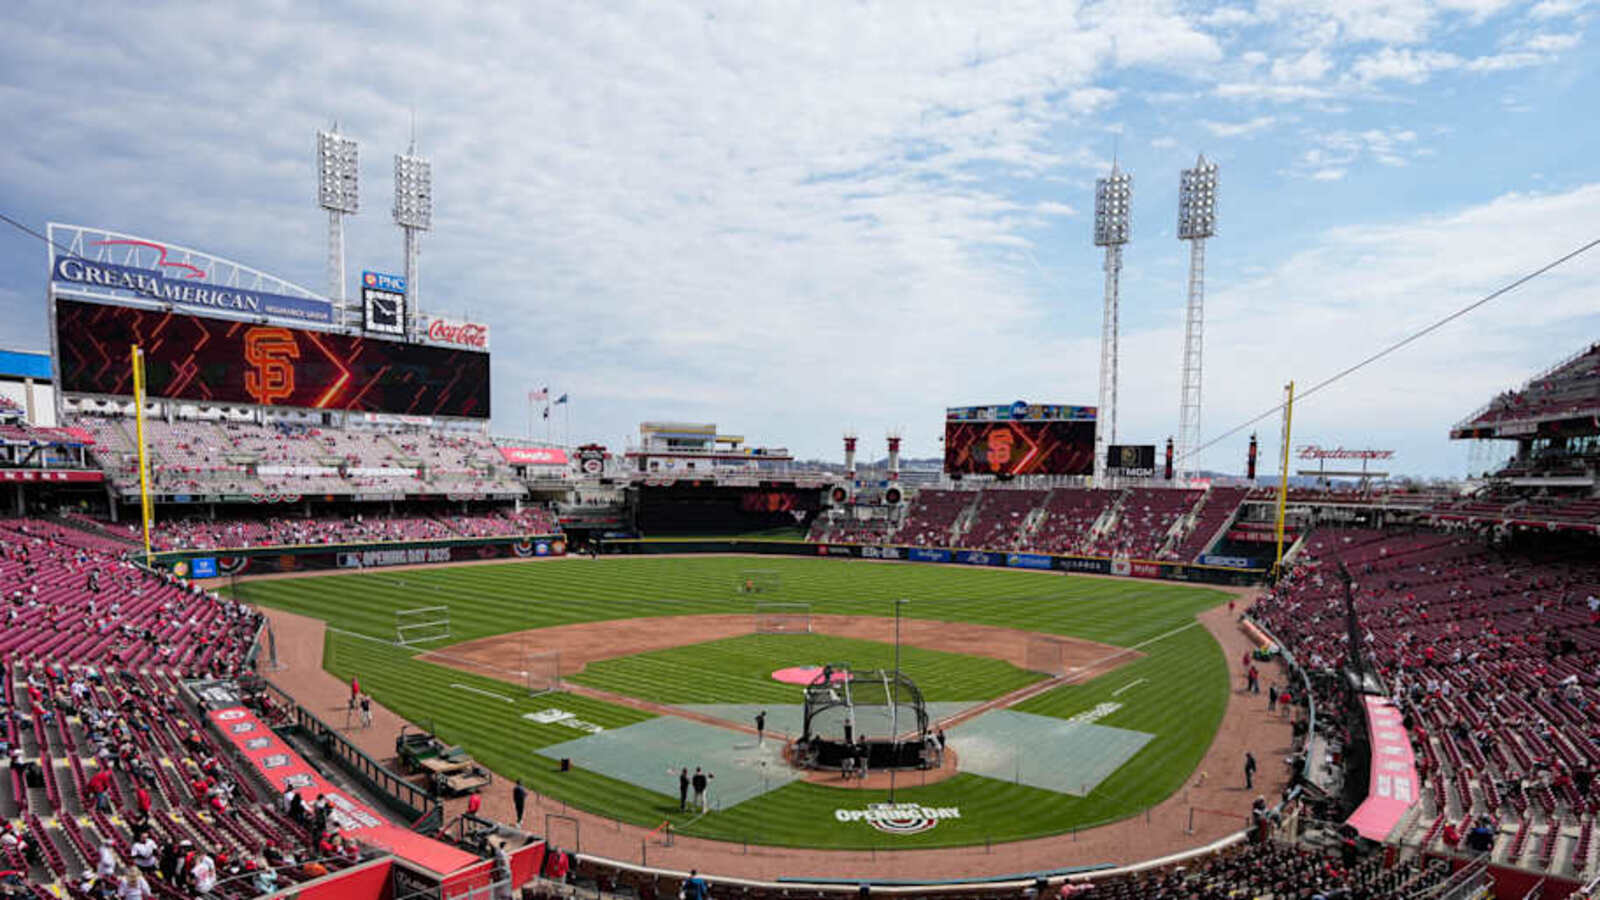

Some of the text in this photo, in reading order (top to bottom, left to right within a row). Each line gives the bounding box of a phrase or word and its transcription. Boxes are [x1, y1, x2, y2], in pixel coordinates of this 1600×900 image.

[60, 260, 260, 310] GREAT AMERICAN
[379, 276, 405, 290] PNC
